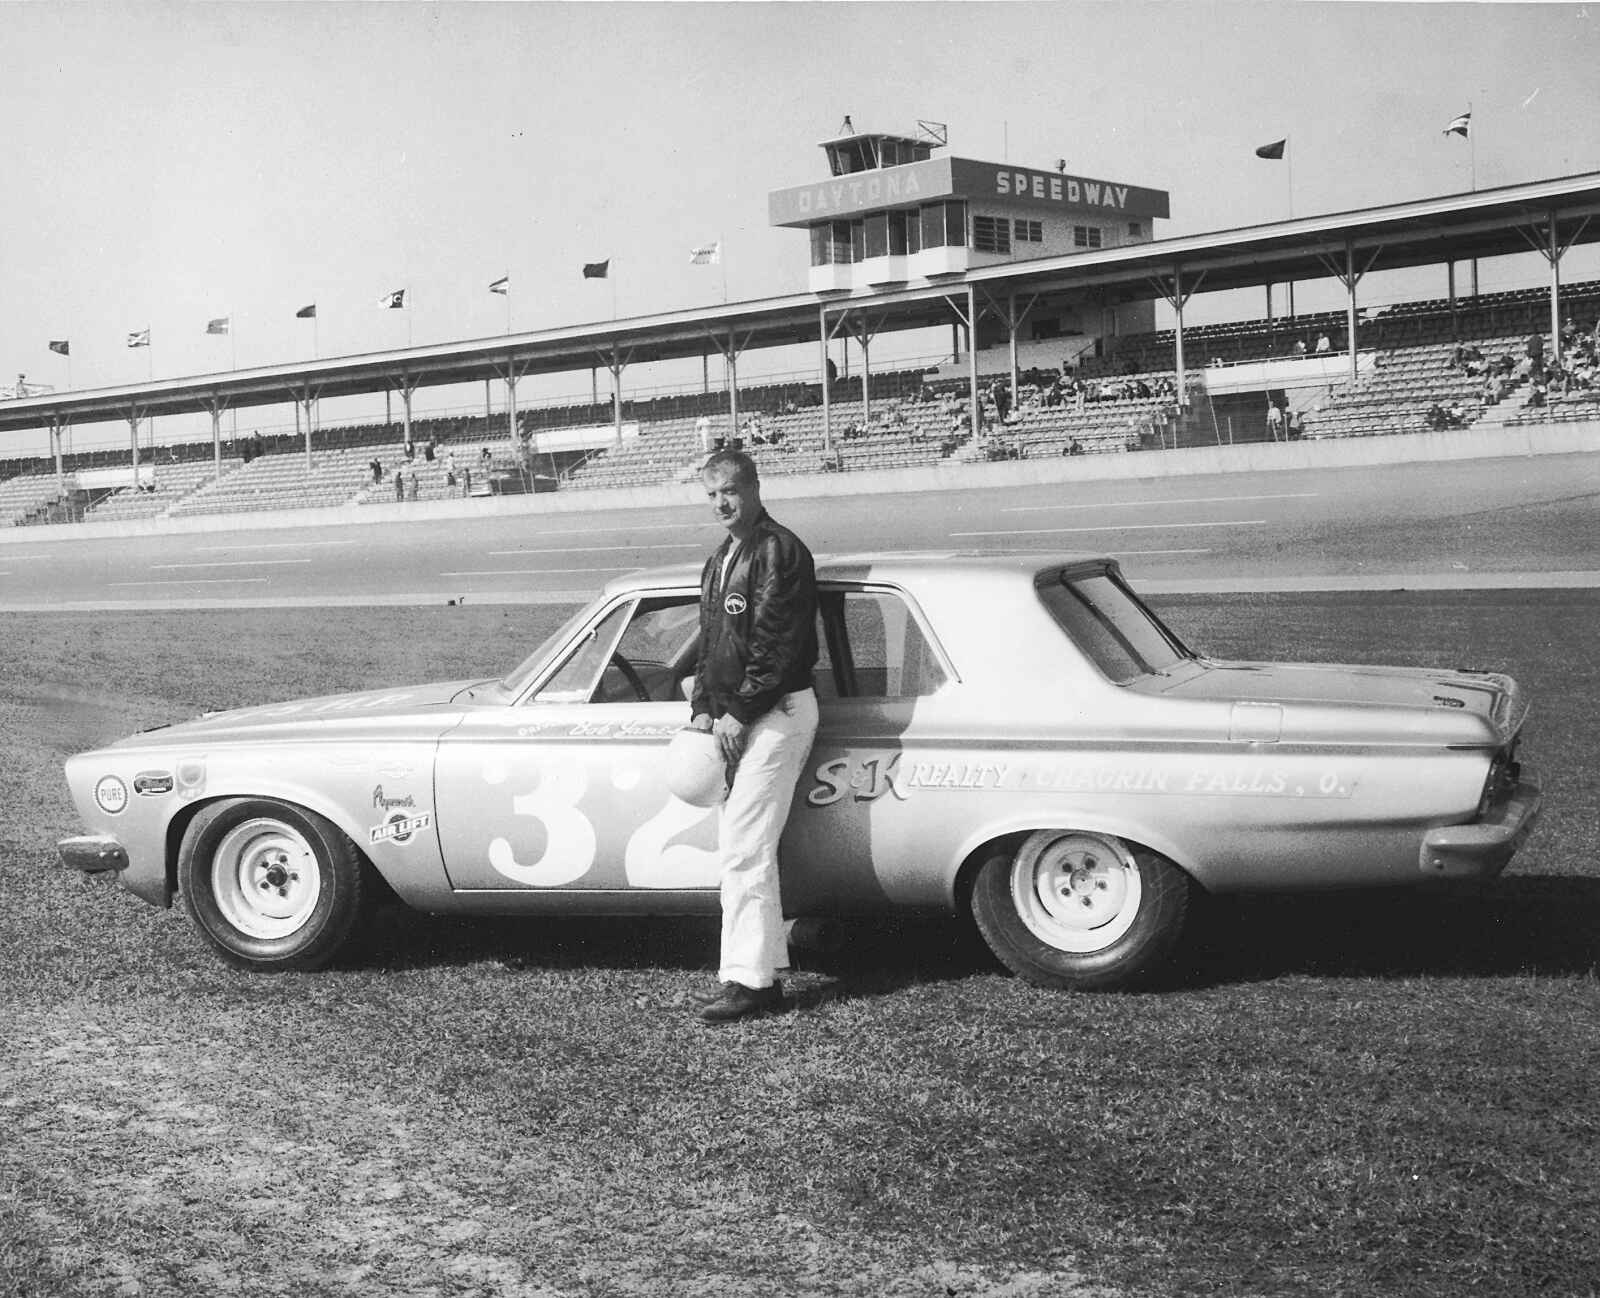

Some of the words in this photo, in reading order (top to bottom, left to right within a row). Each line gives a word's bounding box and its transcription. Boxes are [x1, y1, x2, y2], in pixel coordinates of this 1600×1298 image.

[798, 171, 921, 213] DAYTONA
[996, 171, 1129, 209] SPEEDWAY
[908, 762, 1008, 789] REALTY
[100, 787, 123, 801] PURE
